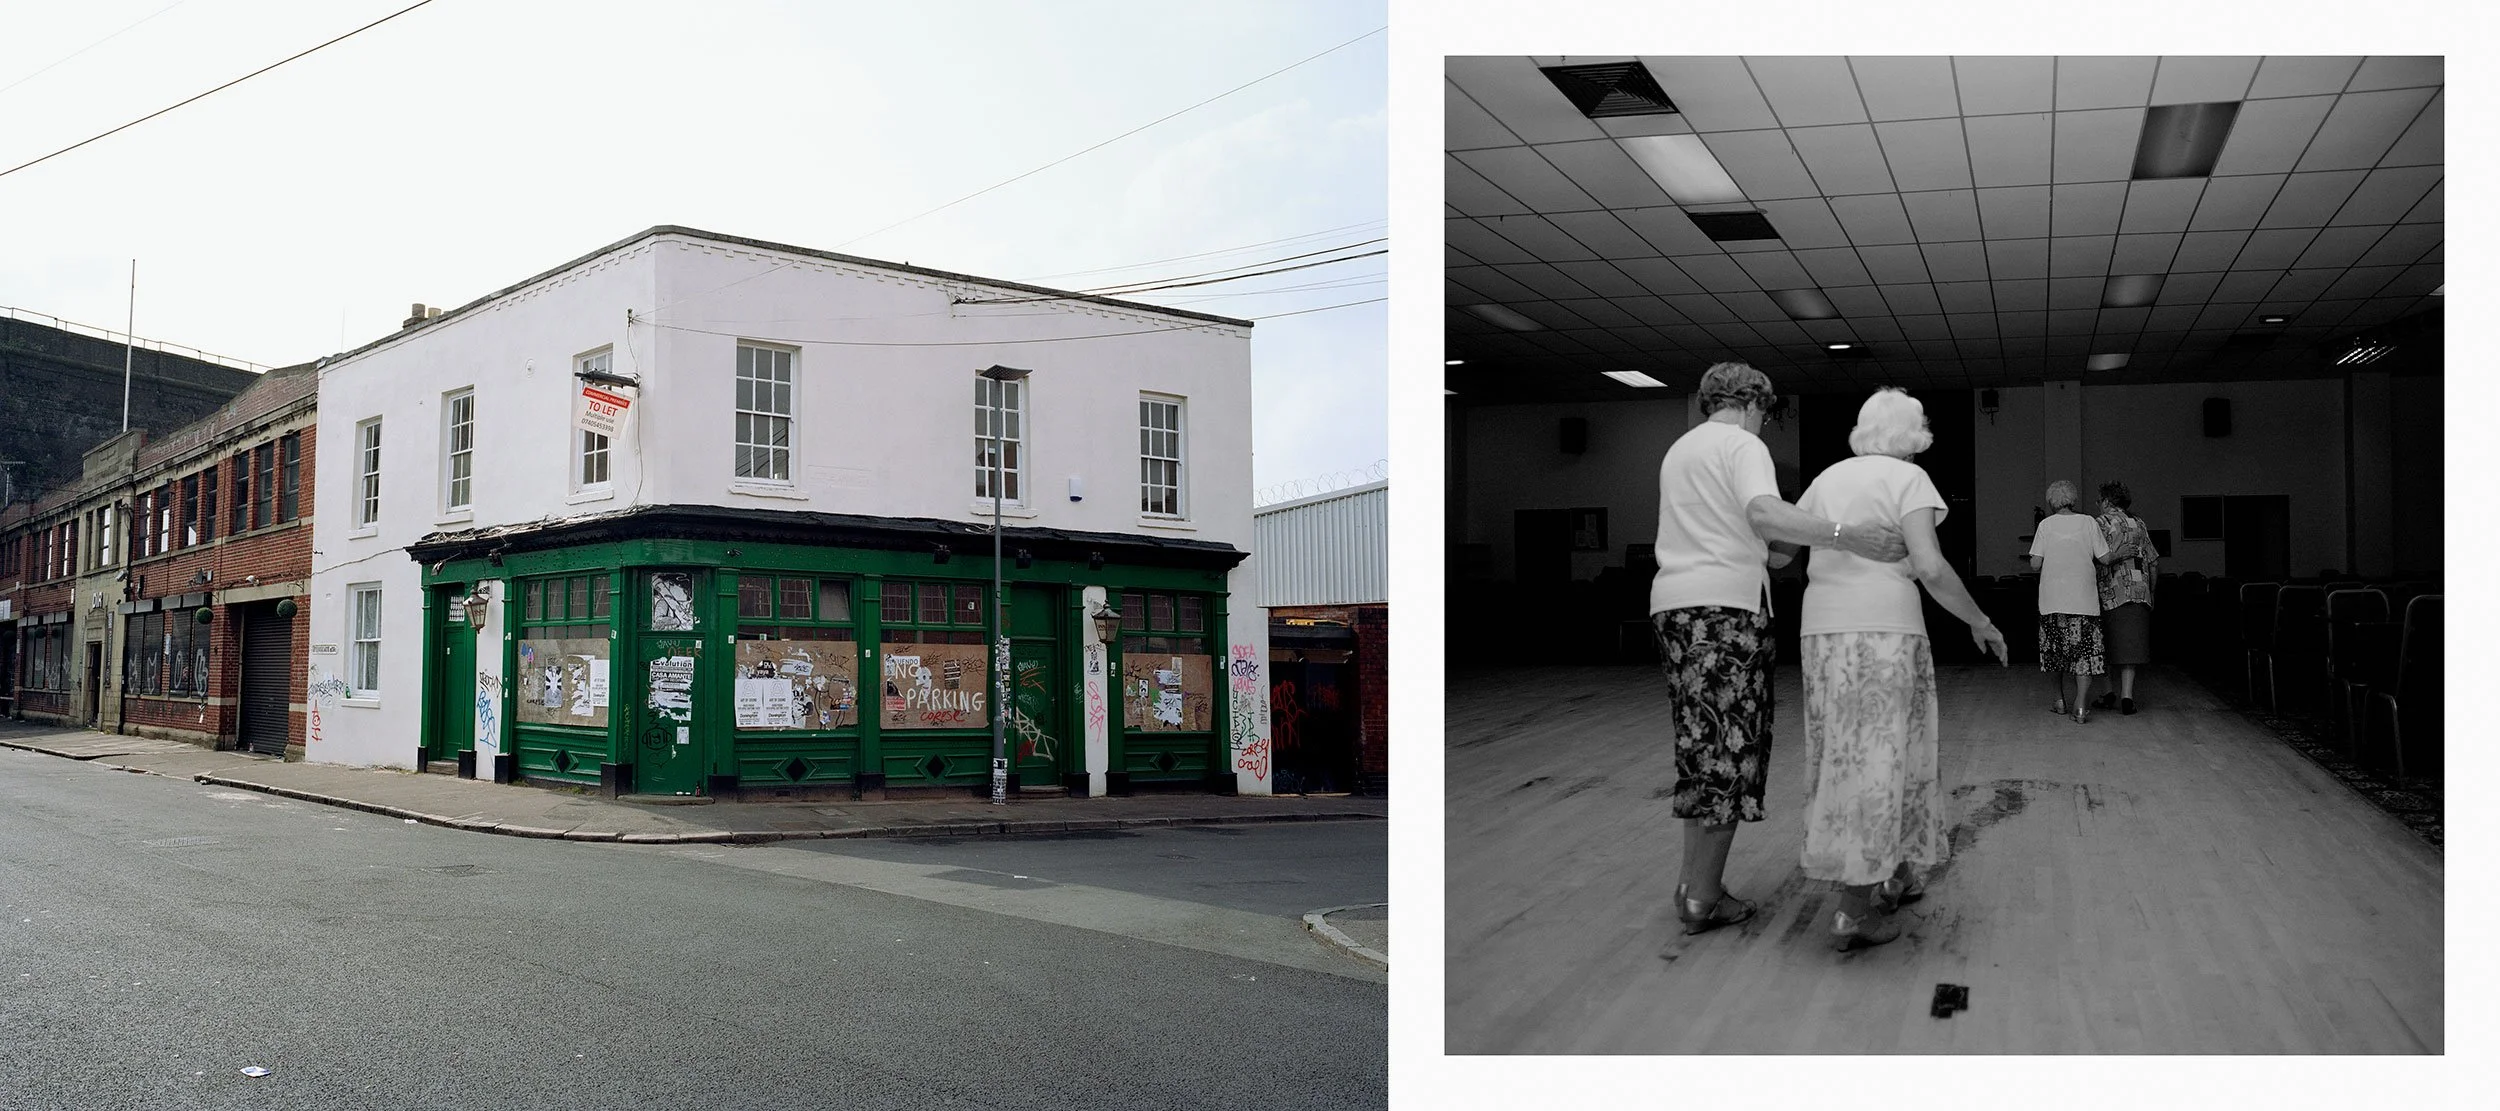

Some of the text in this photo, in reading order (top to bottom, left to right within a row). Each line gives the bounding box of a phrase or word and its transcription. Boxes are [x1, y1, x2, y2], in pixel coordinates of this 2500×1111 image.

[589, 400, 619, 417] TO LET
[906, 688, 985, 713] PARKING
